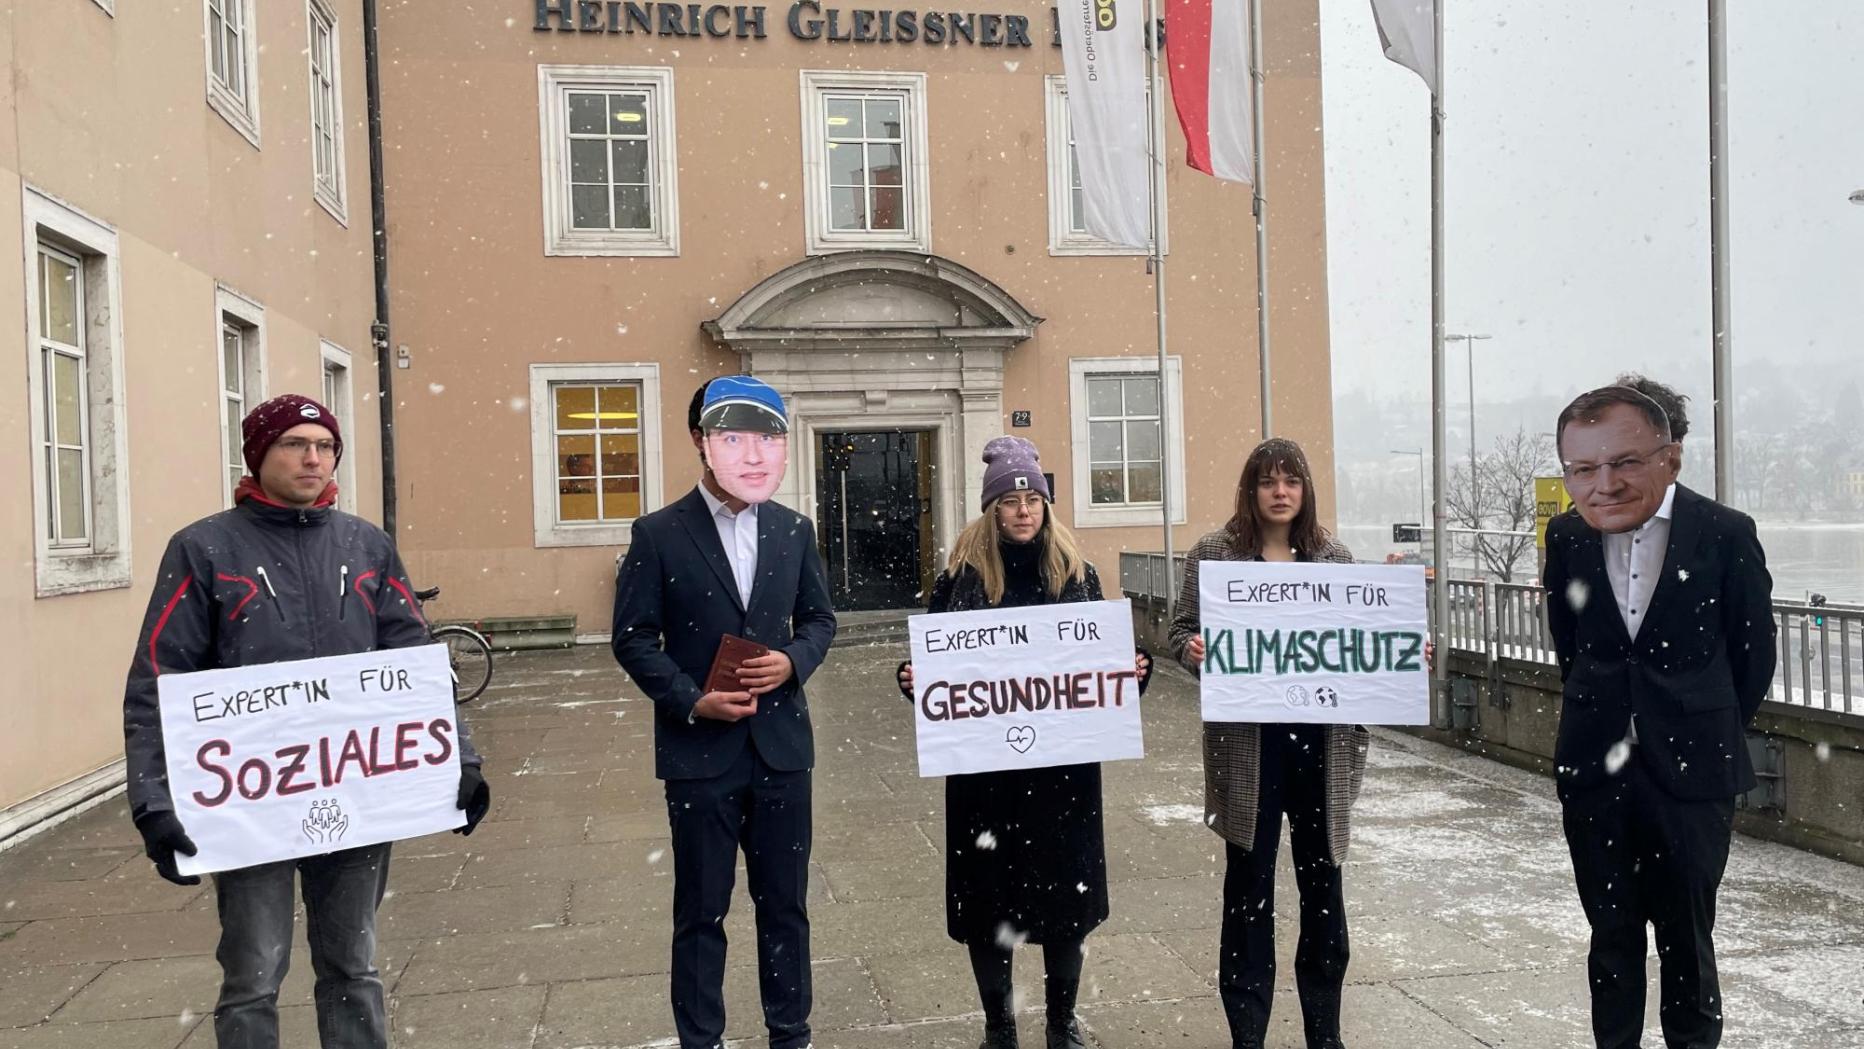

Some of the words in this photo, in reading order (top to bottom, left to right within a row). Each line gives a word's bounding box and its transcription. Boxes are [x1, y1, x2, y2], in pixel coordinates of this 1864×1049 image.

[533, 0, 768, 38] HEINRICH
[787, 0, 1033, 46] GLEISSNER
[1346, 583, 1390, 607] FÜR
[1057, 619, 1101, 641] FÜR
[1204, 627, 1423, 675] KLIMASCHUTZ
[360, 665, 412, 692] FÜR
[921, 670, 1138, 722] GESUNDHEIT
[192, 718, 453, 808] SOZIALES
